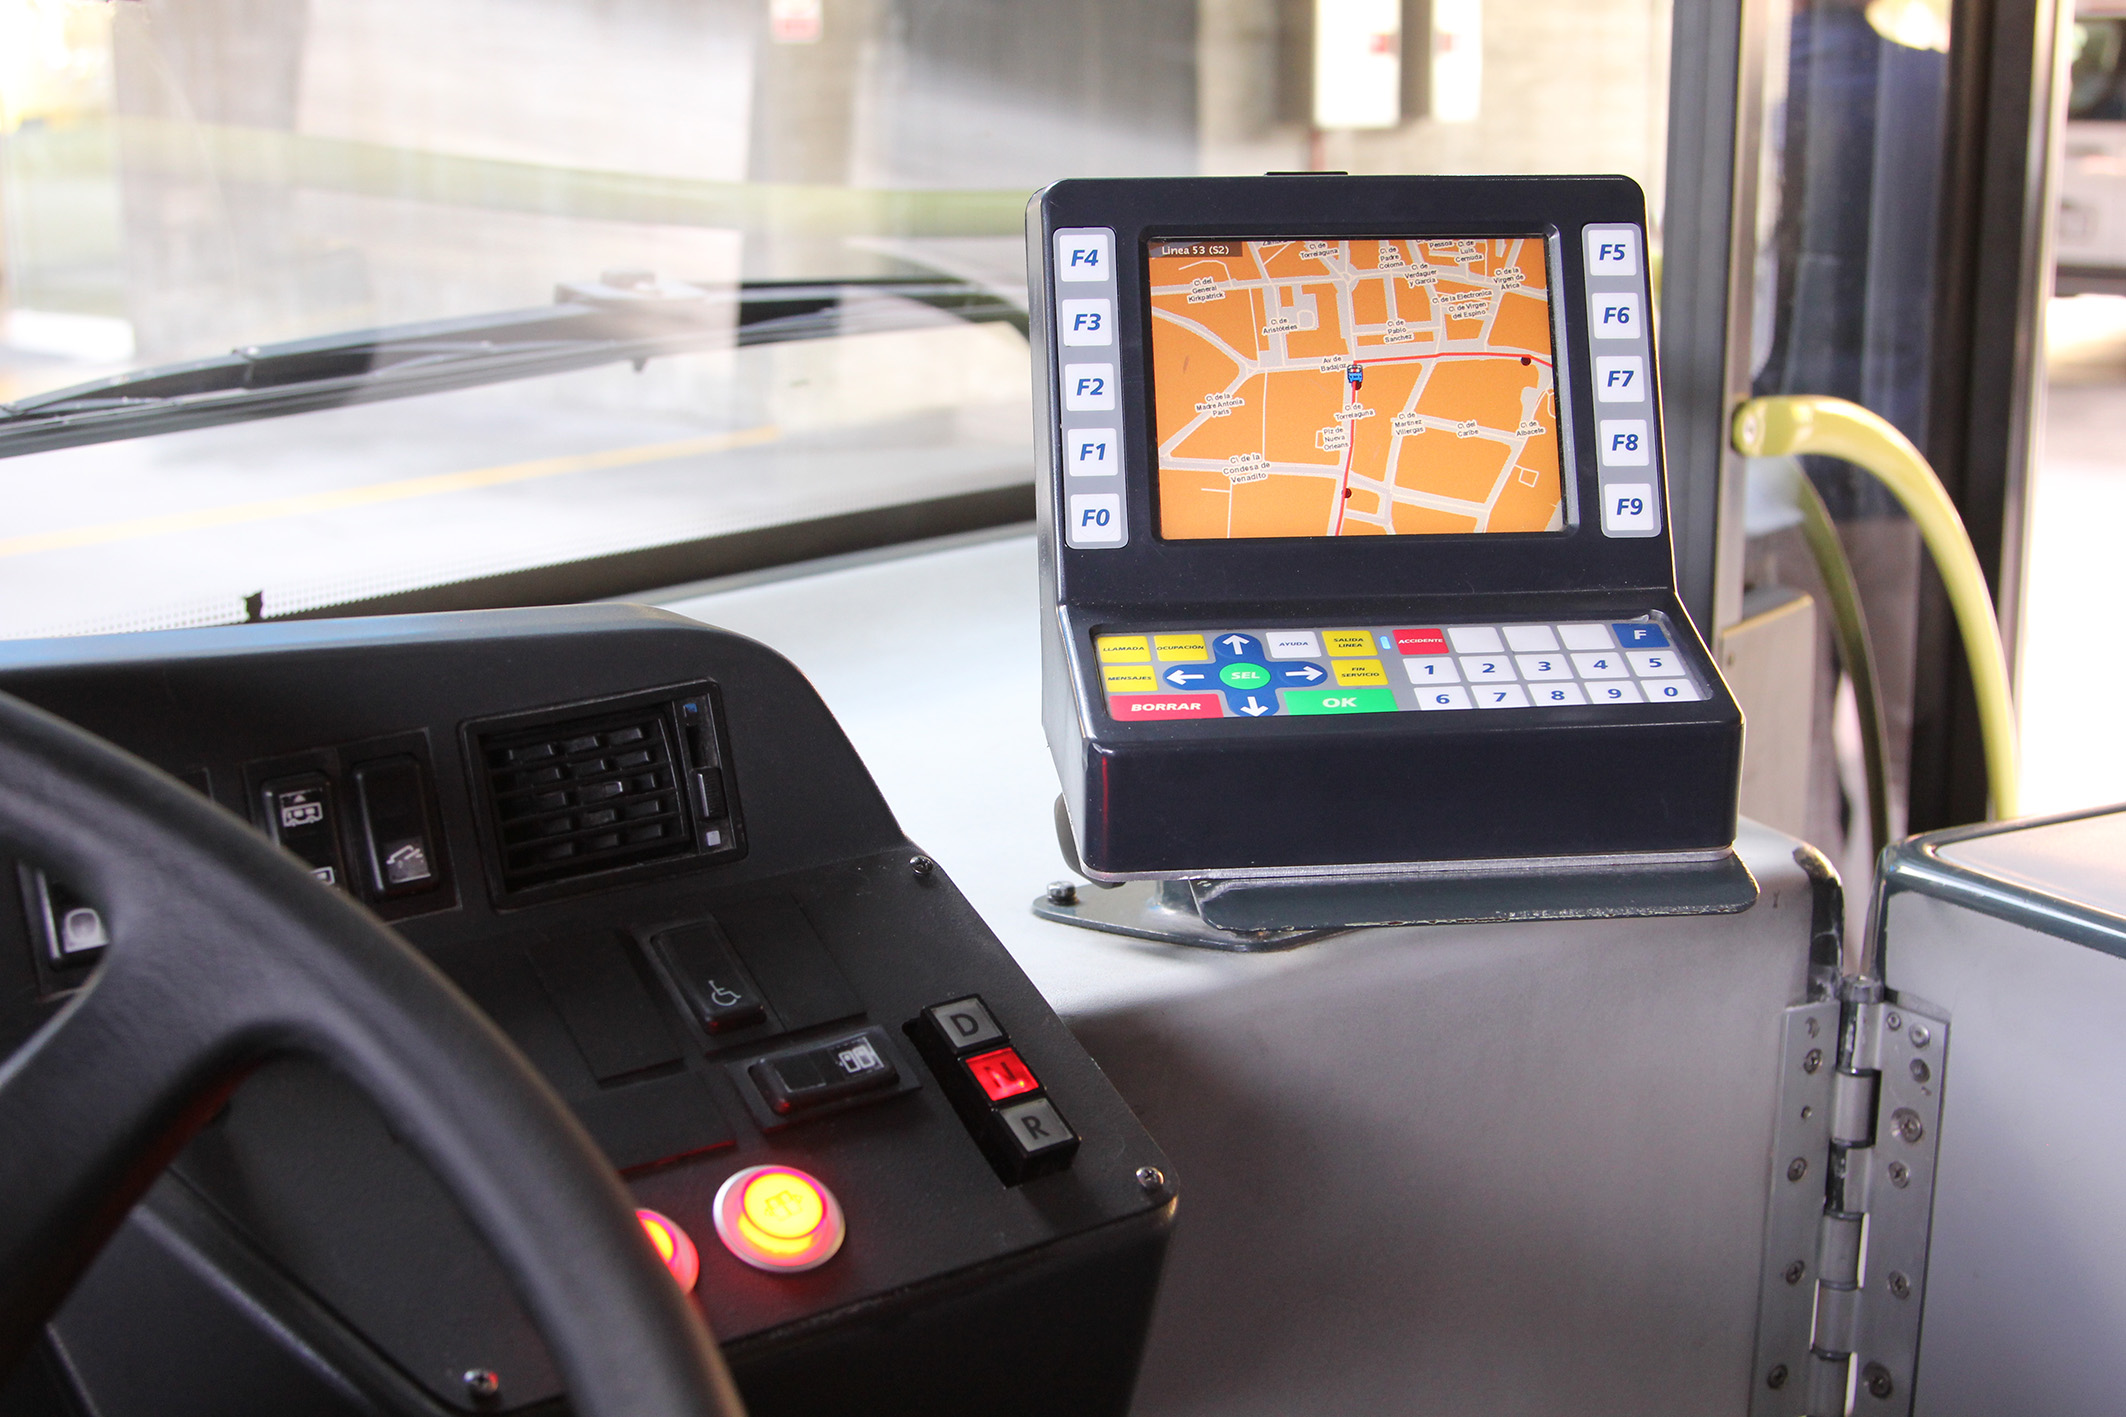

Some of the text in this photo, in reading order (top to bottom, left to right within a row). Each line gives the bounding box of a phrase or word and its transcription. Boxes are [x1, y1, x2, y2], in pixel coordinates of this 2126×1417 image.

[1192, 246, 1206, 255] 53
[1209, 246, 1230, 255] (S2)
[1300, 249, 1338, 259] Torrelaguna
[1599, 244, 1626, 261] F5
[1071, 249, 1099, 267] F4
[1380, 254, 1400, 262] Padre
[1455, 254, 1483, 263] Cernuda
[1378, 261, 1404, 270] Coloma
[1404, 269, 1437, 280] Verdaguer
[1493, 275, 1514, 284] Virgen
[1192, 286, 1218, 295] General
[1187, 293, 1224, 303] Kirkpatrick
[1466, 302, 1487, 310] Virgen
[1463, 309, 1486, 318] Espino
[1603, 307, 1630, 324] F6
[1073, 313, 1102, 331] F3
[1387, 326, 1407, 334] Pablo
[1320, 362, 1346, 372] Badajoz
[1607, 370, 1634, 387] F7
[1076, 378, 1104, 396] F2
[1196, 398, 1243, 411] Madre Antonia
[1335, 409, 1374, 420] Torrelaguna
[1396, 426, 1424, 436] Villergas
[1457, 429, 1478, 437] Caribe
[1516, 427, 1544, 437] Albacete
[1323, 442, 1349, 451] Orleans
[1611, 433, 1639, 451] F8
[1079, 443, 1106, 461] F1
[1223, 465, 1259, 475] Condesa
[1230, 473, 1267, 483] Venadito
[1616, 497, 1643, 515] F9
[1634, 629, 1647, 640] F
[1538, 661, 1552, 672] 3
[1593, 659, 1609, 670] 4
[1649, 657, 1662, 668] 5
[1424, 665, 1434, 675] 1
[1482, 663, 1496, 673] 2
[1231, 671, 1260, 680] SEL
[1551, 690, 1565, 700] 8
[1608, 688, 1622, 699] 9
[1664, 686, 1678, 697] 0
[1436, 694, 1450, 704] 6
[1493, 692, 1507, 702] 7
[1131, 702, 1202, 712] BORRAR
[1322, 697, 1358, 708] OK
[951, 1013, 979, 1037] D
[984, 1061, 1016, 1088] N
[1021, 1115, 1050, 1140] R
